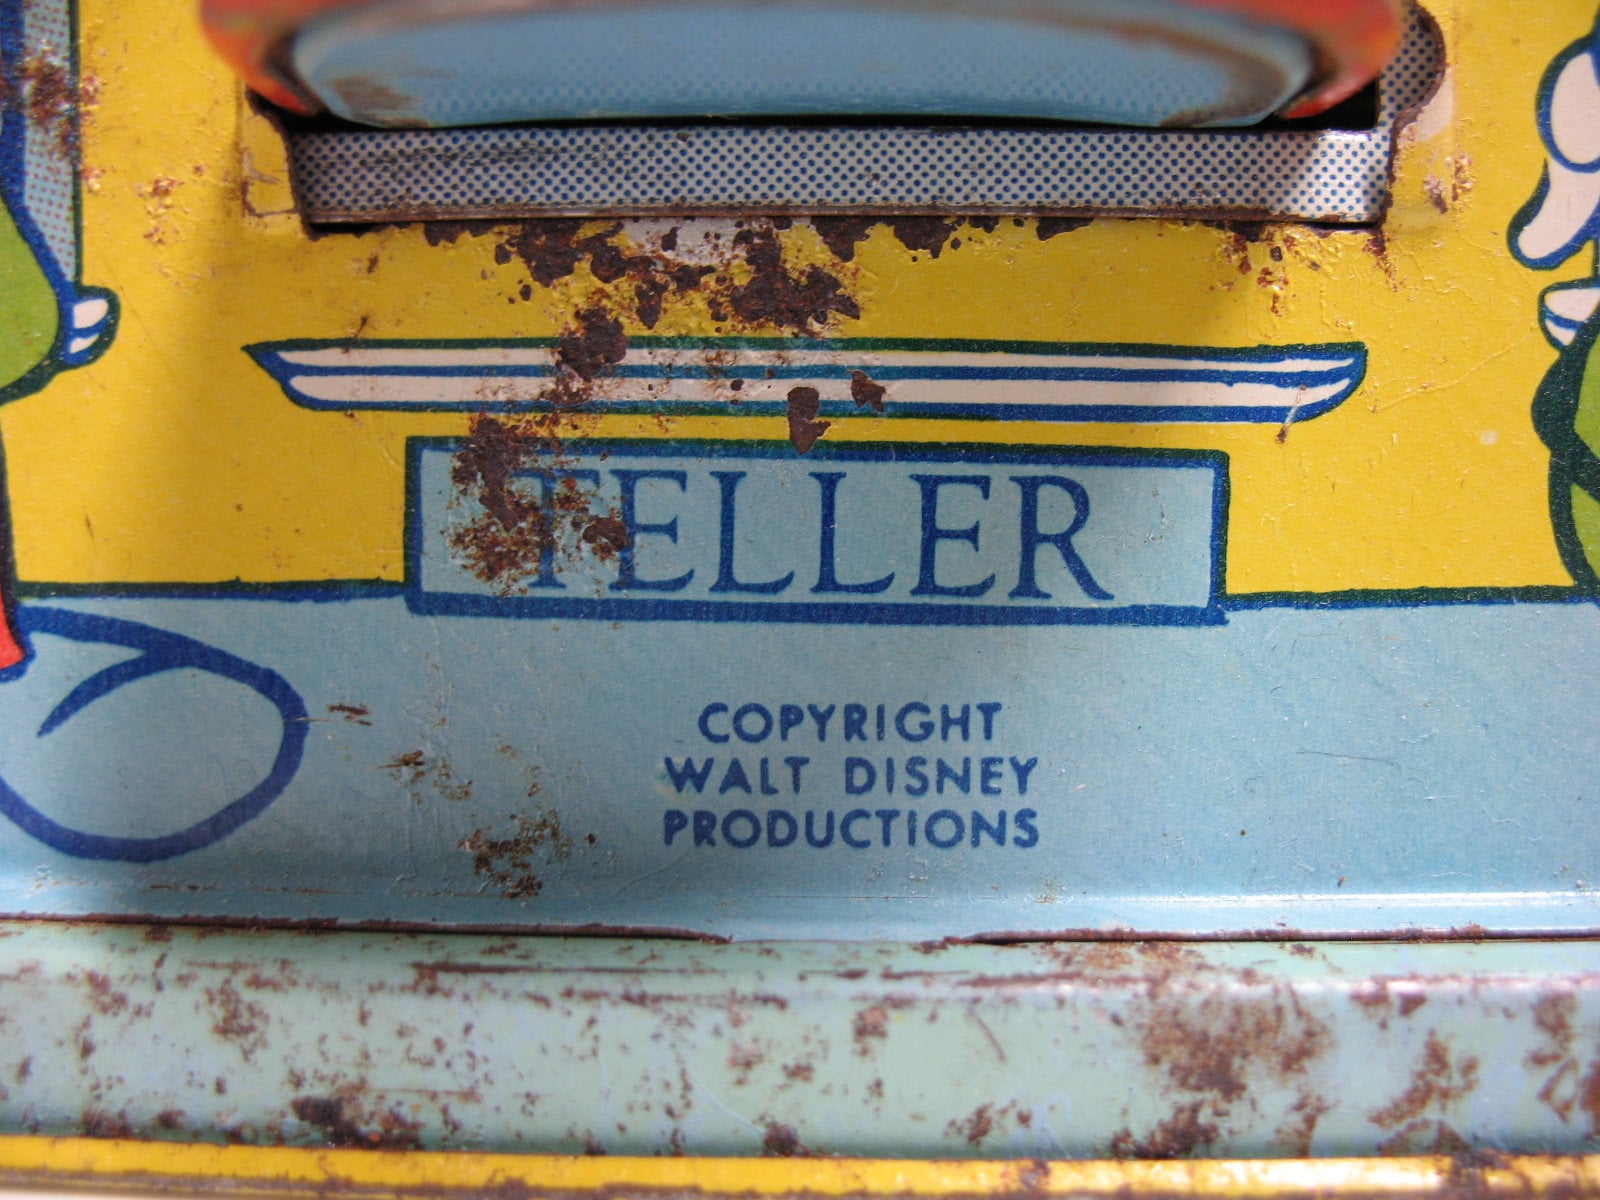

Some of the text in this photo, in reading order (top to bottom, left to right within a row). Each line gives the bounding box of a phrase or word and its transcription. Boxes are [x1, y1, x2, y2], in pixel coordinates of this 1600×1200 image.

[510, 468, 1115, 601] TELLER
[697, 701, 1003, 744] COPYRIGHT
[664, 755, 1039, 797] WALT DISNEY
[663, 807, 1040, 849] PRODUCTIONS
